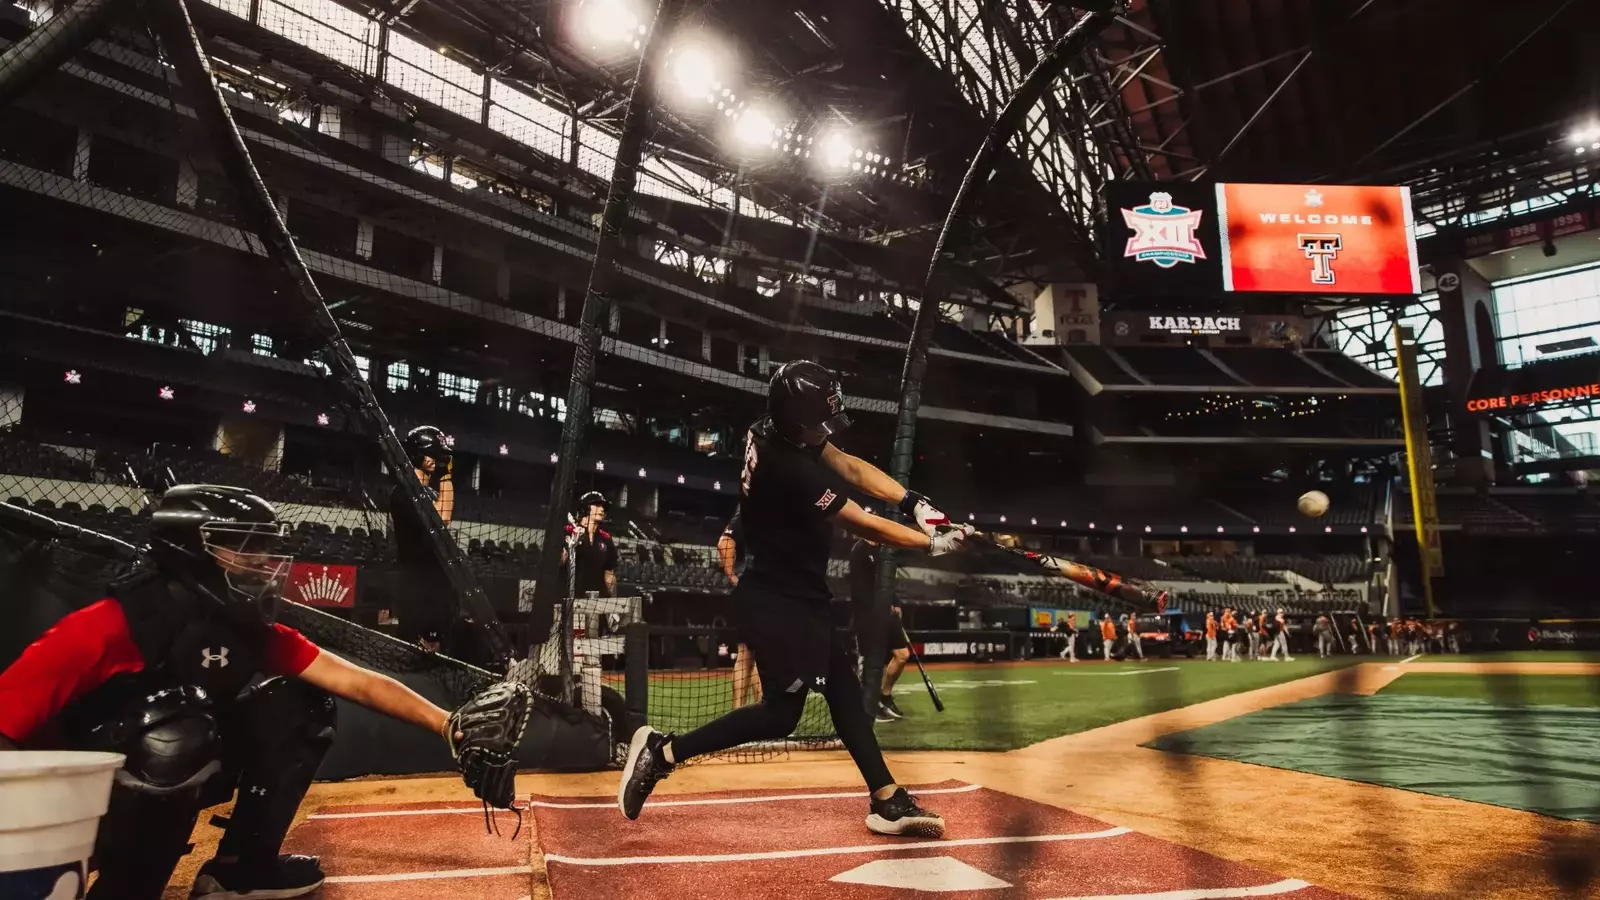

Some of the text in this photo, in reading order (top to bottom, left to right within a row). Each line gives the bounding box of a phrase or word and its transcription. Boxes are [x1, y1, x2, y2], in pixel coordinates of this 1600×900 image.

[1259, 213, 1373, 225] WELCOME
[1553, 212, 1582, 227] 1999
[1509, 224, 1537, 237] 1998
[1440, 276, 1457, 287] 42
[1467, 397, 1506, 411] CORE
